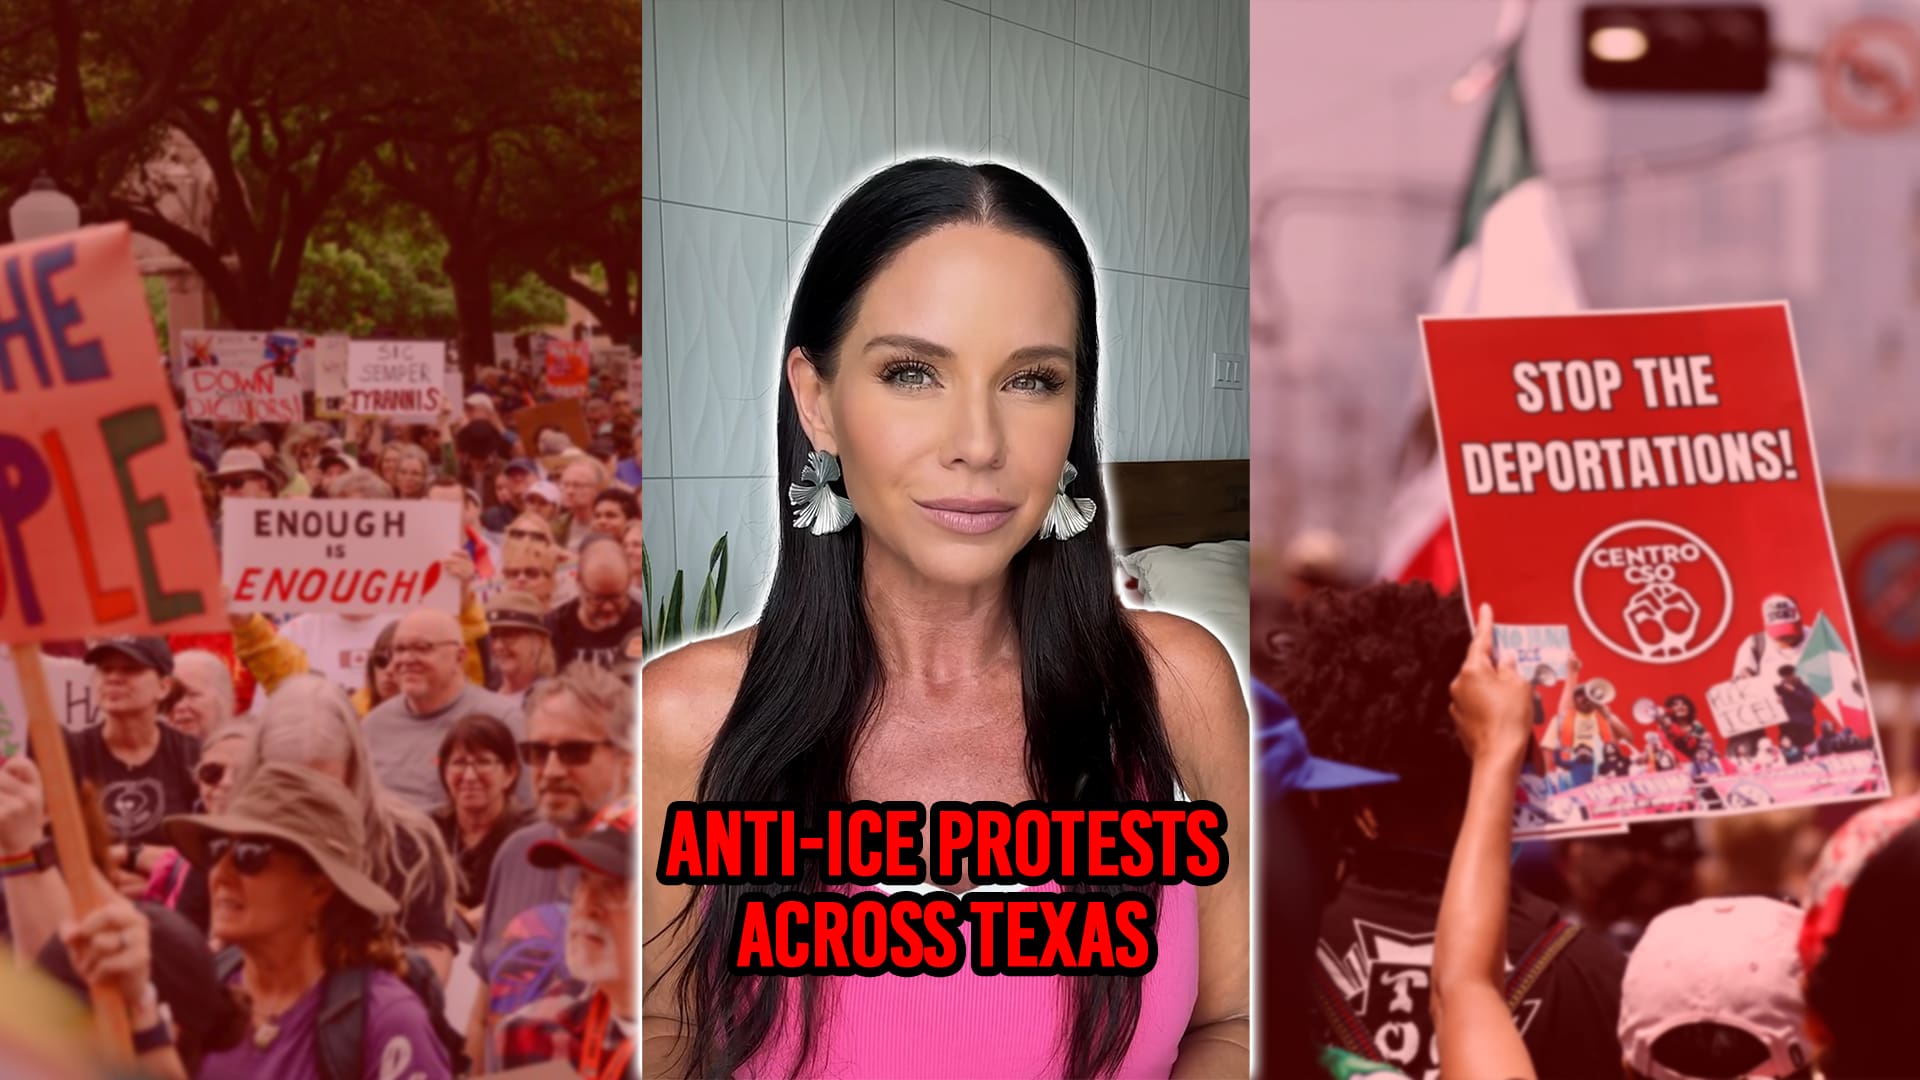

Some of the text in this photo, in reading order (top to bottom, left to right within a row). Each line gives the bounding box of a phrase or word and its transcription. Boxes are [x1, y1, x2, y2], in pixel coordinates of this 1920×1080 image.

[377, 343, 415, 361] SIC
[192, 366, 275, 395] DOWN
[359, 361, 432, 383] SEMPER
[1512, 354, 1720, 413] STOP THE
[349, 387, 440, 412] TYRANNIS
[1461, 428, 1798, 495] DEPORTATIONS!
[0, 404, 206, 627] PLE
[254, 509, 406, 538] ENOUGH
[326, 545, 346, 559] IS
[1593, 543, 1700, 568] CENTRO
[1624, 563, 1675, 585] CSO
